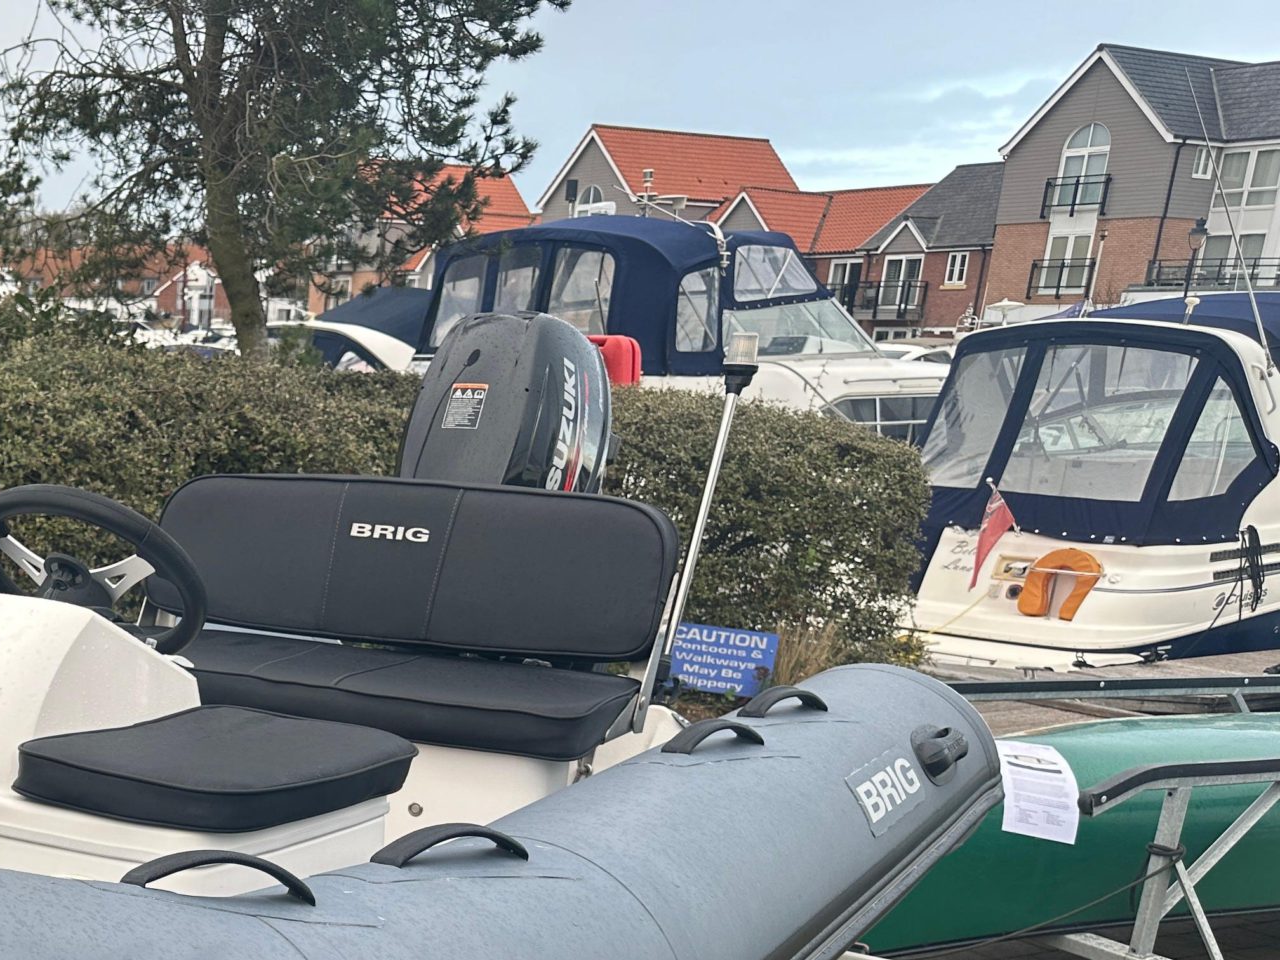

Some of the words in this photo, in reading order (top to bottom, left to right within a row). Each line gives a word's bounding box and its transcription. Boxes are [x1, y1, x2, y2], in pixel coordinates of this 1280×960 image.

[545, 357, 576, 491] SUZUKI
[350, 522, 430, 543] BRIG
[676, 626, 768, 649] CAUTION
[673, 639, 746, 657] Pontoons
[751, 650, 763, 659] &
[675, 651, 756, 670] Walkways
[683, 663, 717, 677] May
[721, 668, 742, 680] Be
[856, 758, 920, 823] BRIG
